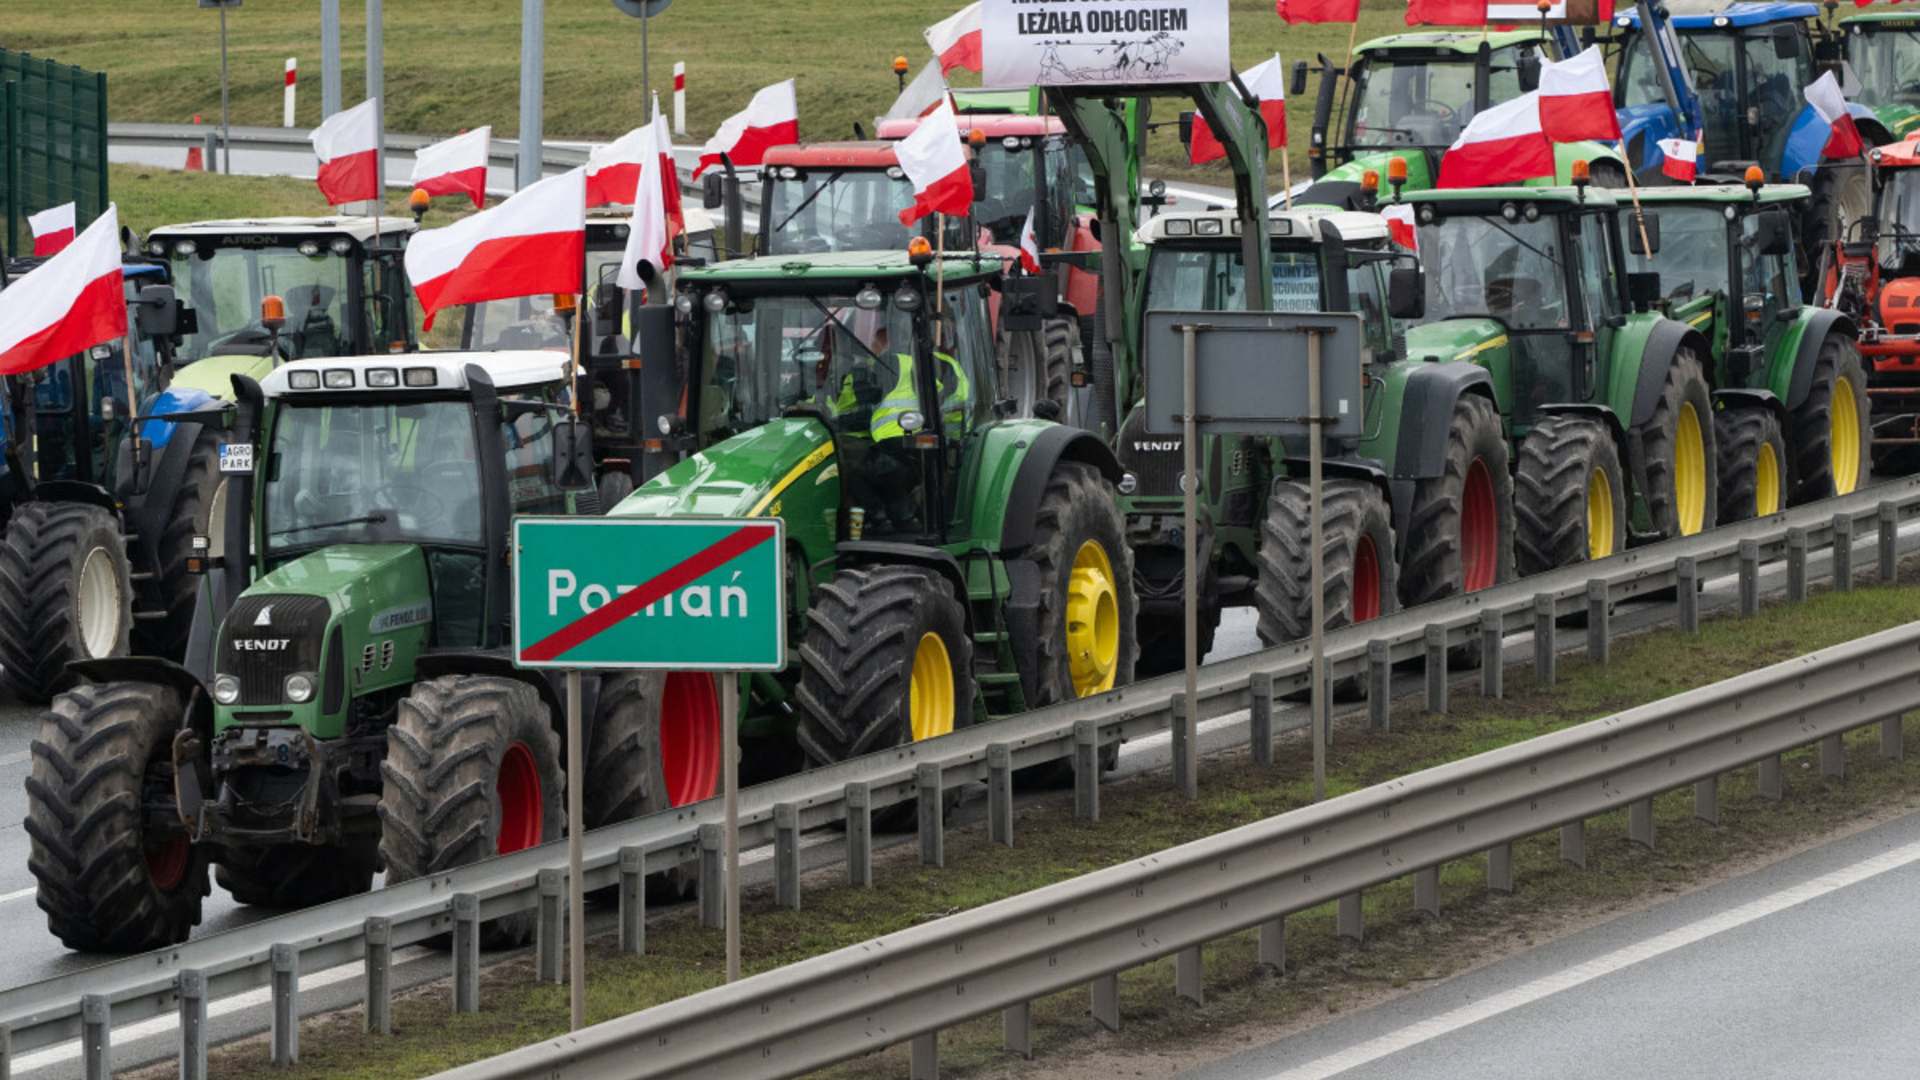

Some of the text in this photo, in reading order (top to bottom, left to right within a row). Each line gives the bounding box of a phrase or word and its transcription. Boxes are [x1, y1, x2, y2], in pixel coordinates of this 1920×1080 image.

[1018, 8, 1187, 34] LEŻAŁA ODŁOGIEM
[222, 235, 278, 244] ARION
[1273, 282, 1319, 295] JCOWIZNA
[227, 446, 251, 457] AGRO
[1133, 441, 1181, 451] FENDT
[222, 459, 250, 468] PARK
[233, 639, 290, 651] FENDT
